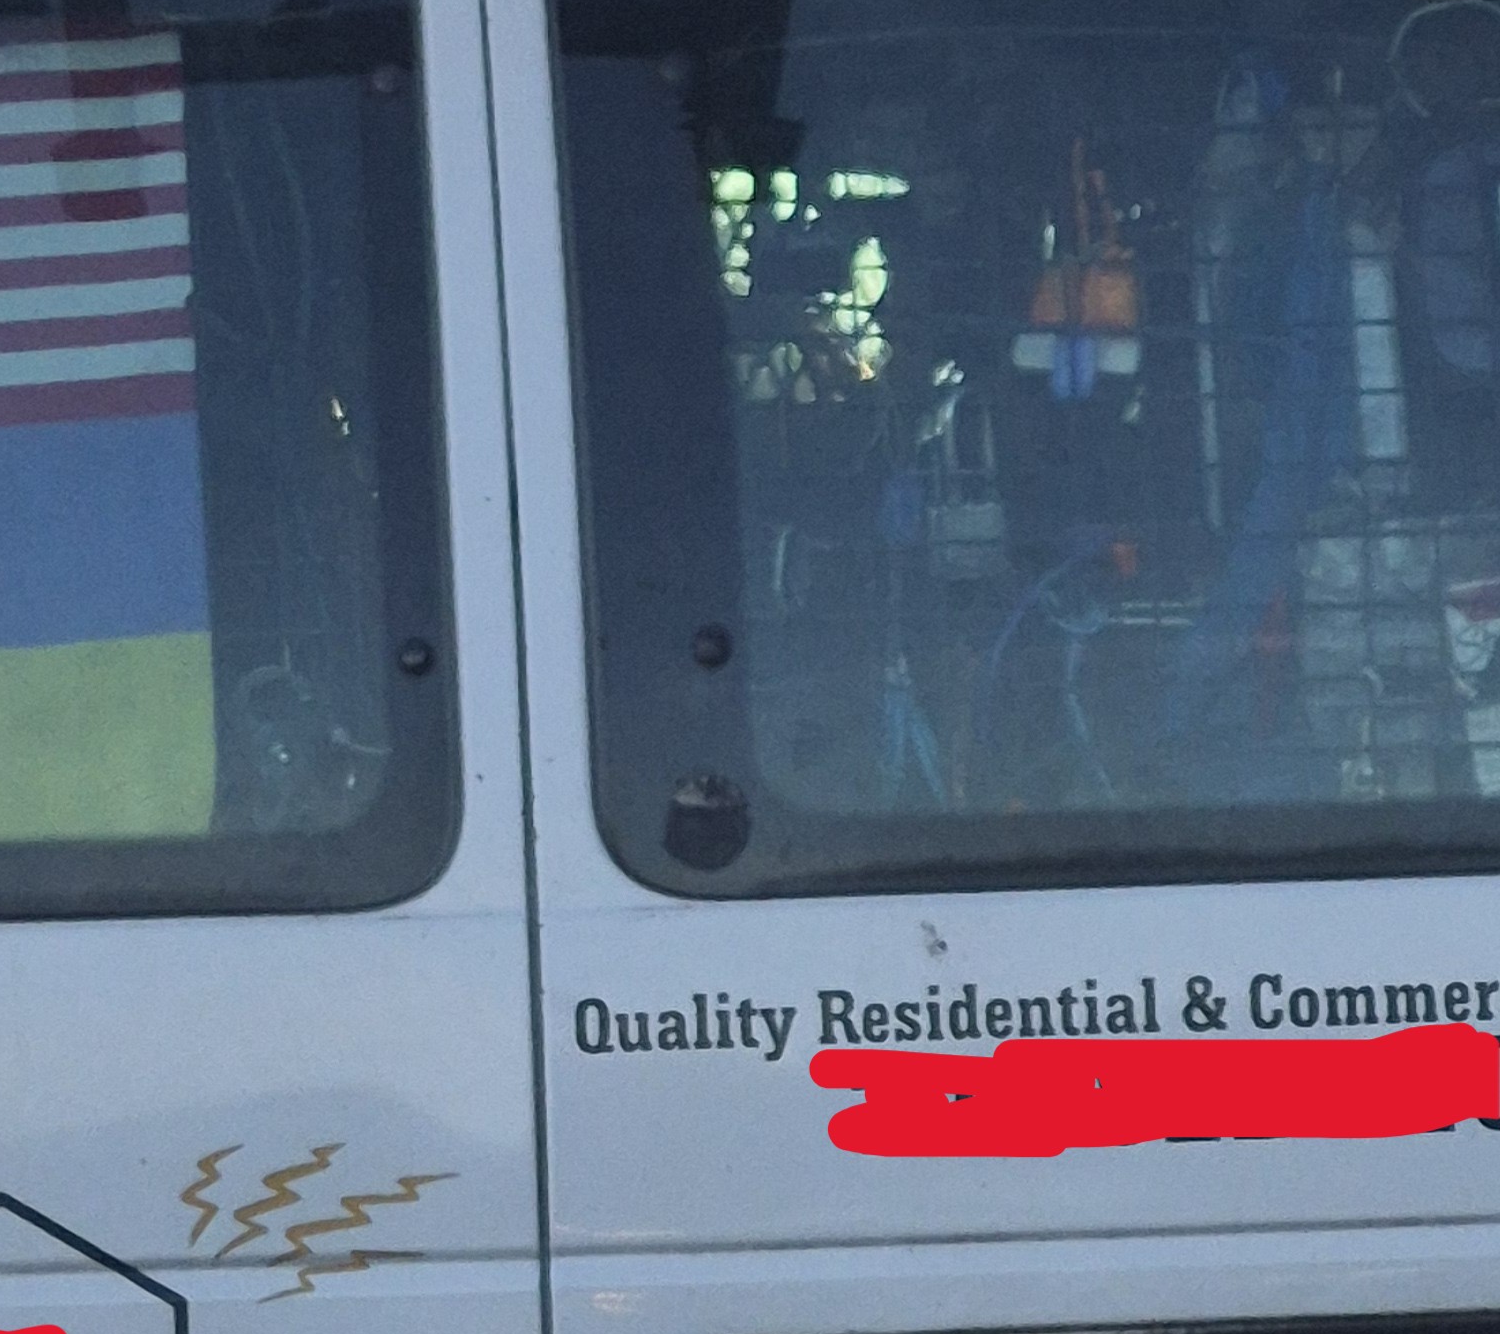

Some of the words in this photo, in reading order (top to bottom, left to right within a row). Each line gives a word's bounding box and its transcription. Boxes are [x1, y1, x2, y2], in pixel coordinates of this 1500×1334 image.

[574, 992, 797, 1062] Quality
[817, 978, 1161, 1045] Residential
[1182, 975, 1228, 1033] &
[1249, 973, 1500, 1030] Commer
